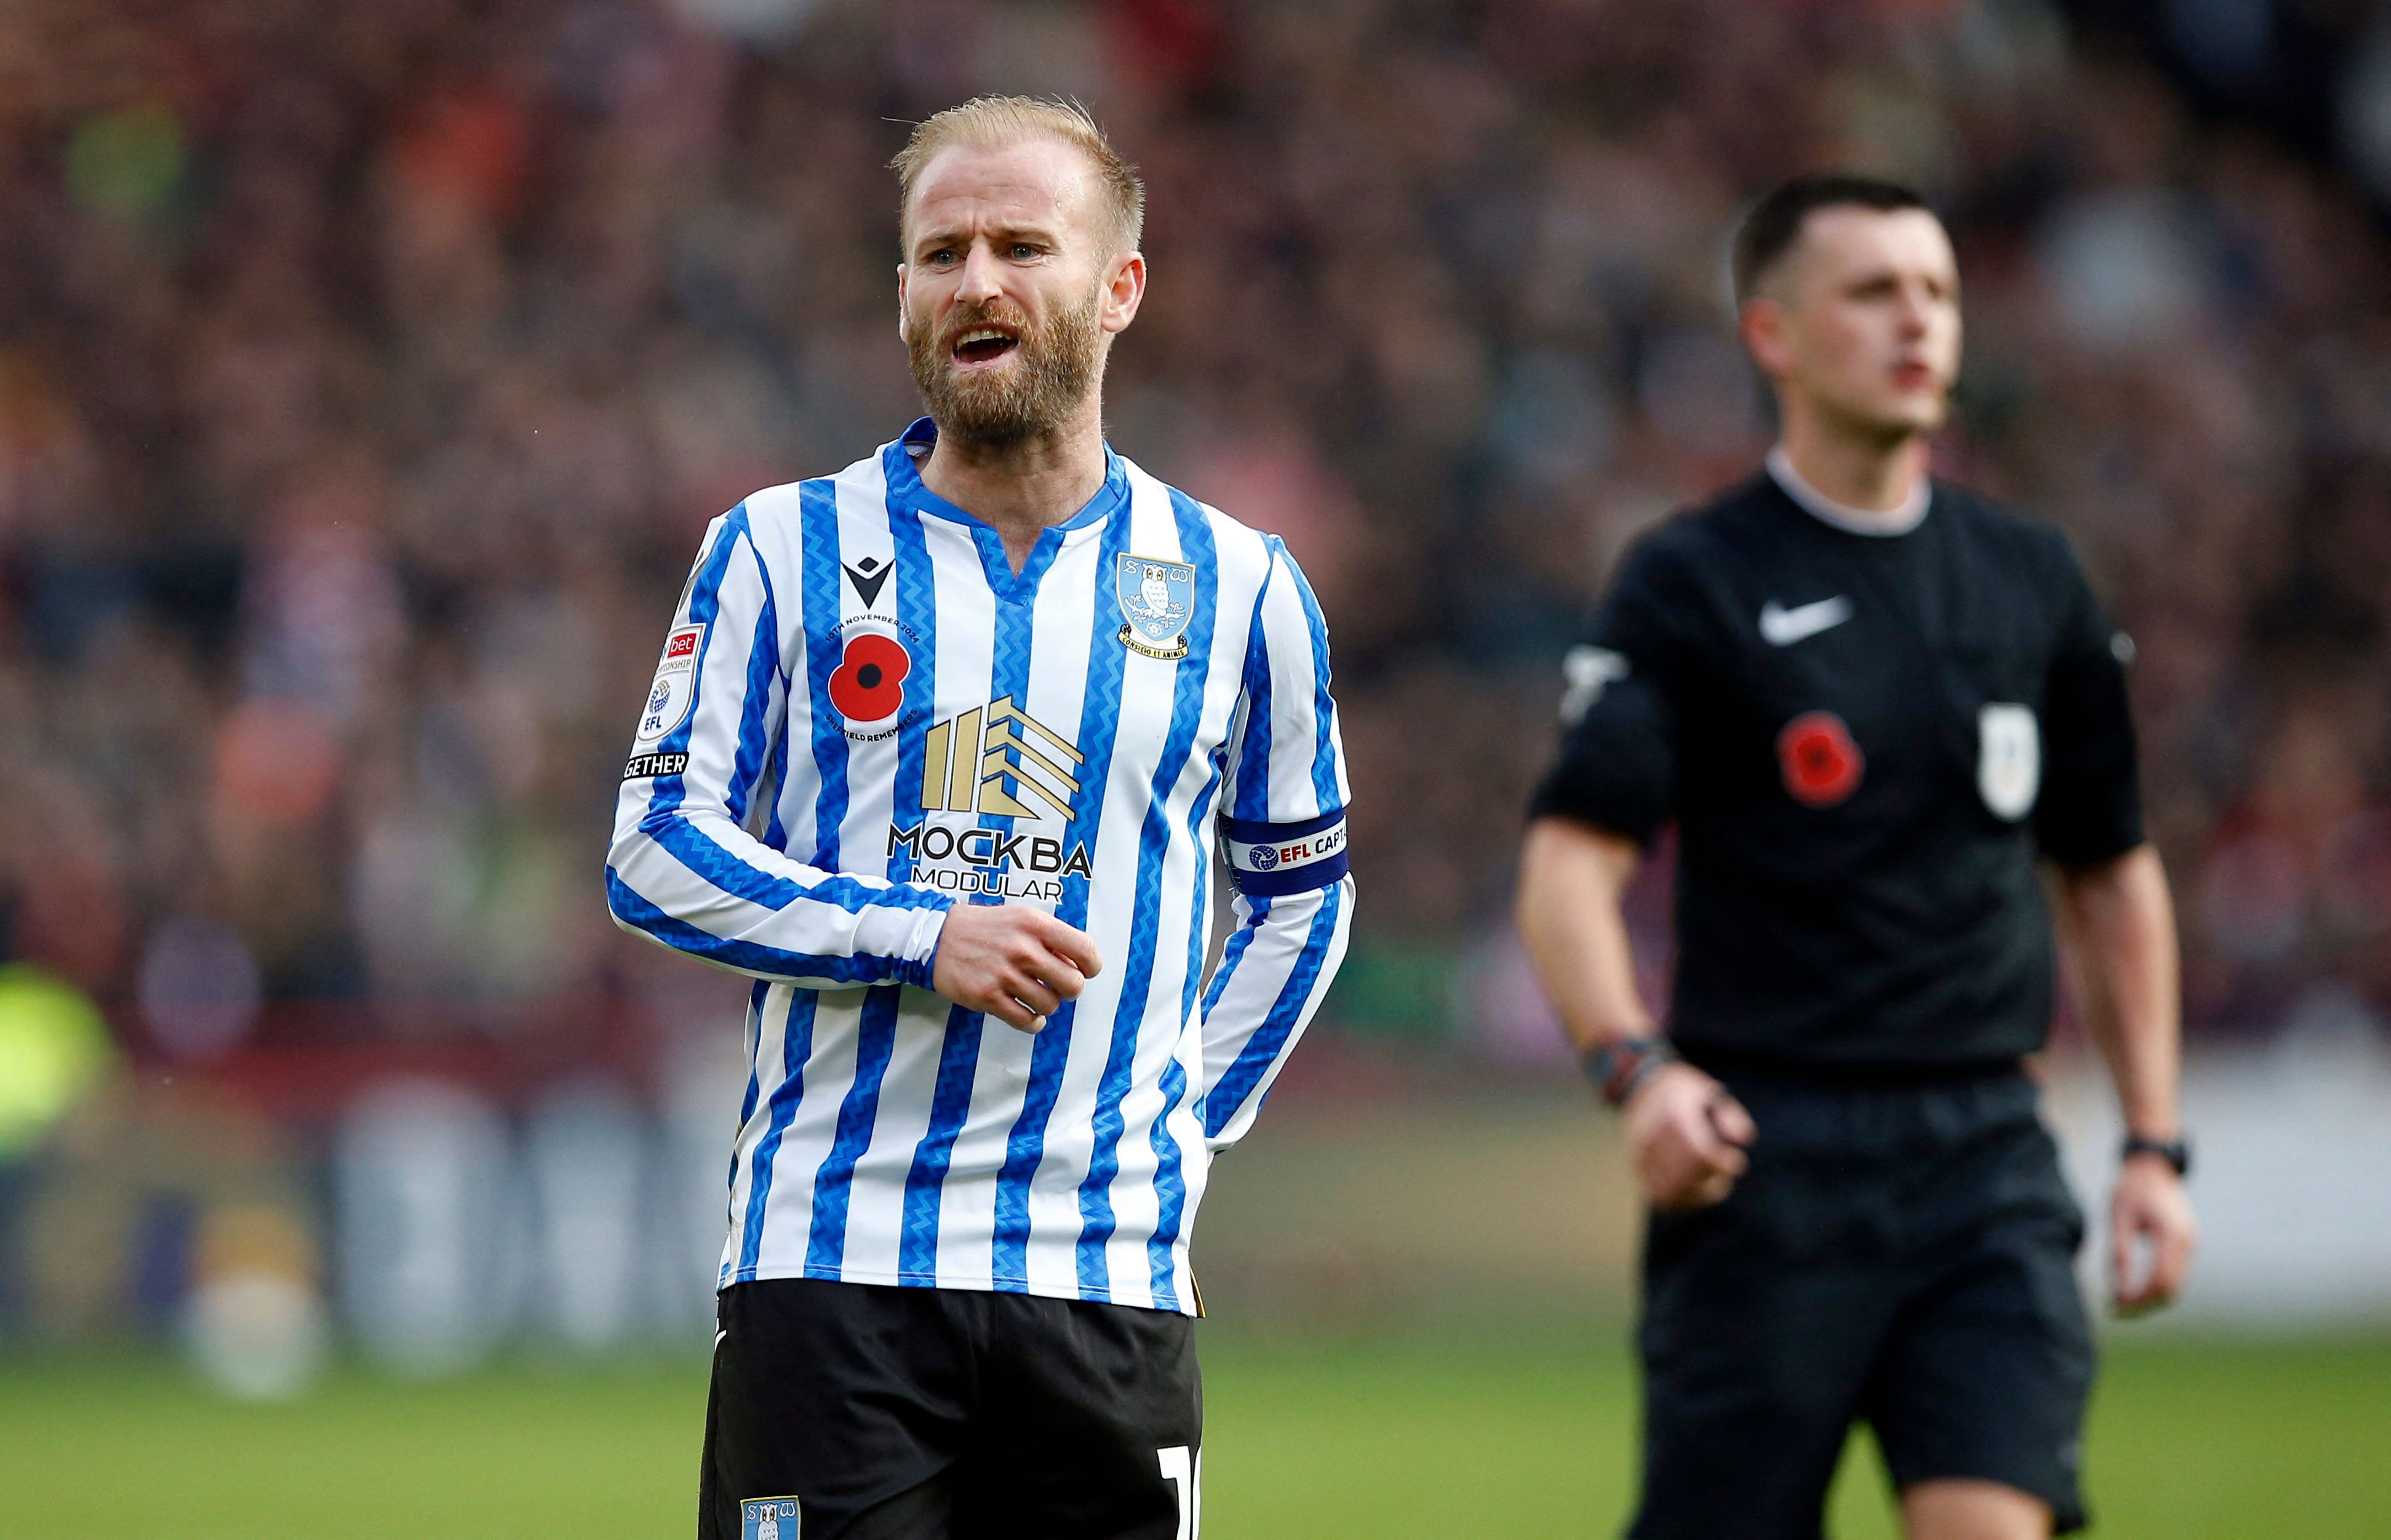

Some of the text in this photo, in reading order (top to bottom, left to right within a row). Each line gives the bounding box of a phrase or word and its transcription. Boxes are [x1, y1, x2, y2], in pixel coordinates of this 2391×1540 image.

[824, 614, 920, 644] 10TH NOVEMBER 2024
[670, 636, 693, 653] bet
[1154, 649, 1160, 658] ET
[1162, 649, 1184, 658] ANIMIS
[644, 716, 661, 731] EFL
[826, 709, 917, 742] SHEFFIELD REMEMBERS
[886, 824, 1092, 880] MOCKBA
[1280, 844, 1311, 863] EFL
[913, 867, 1063, 902] MODULAR
